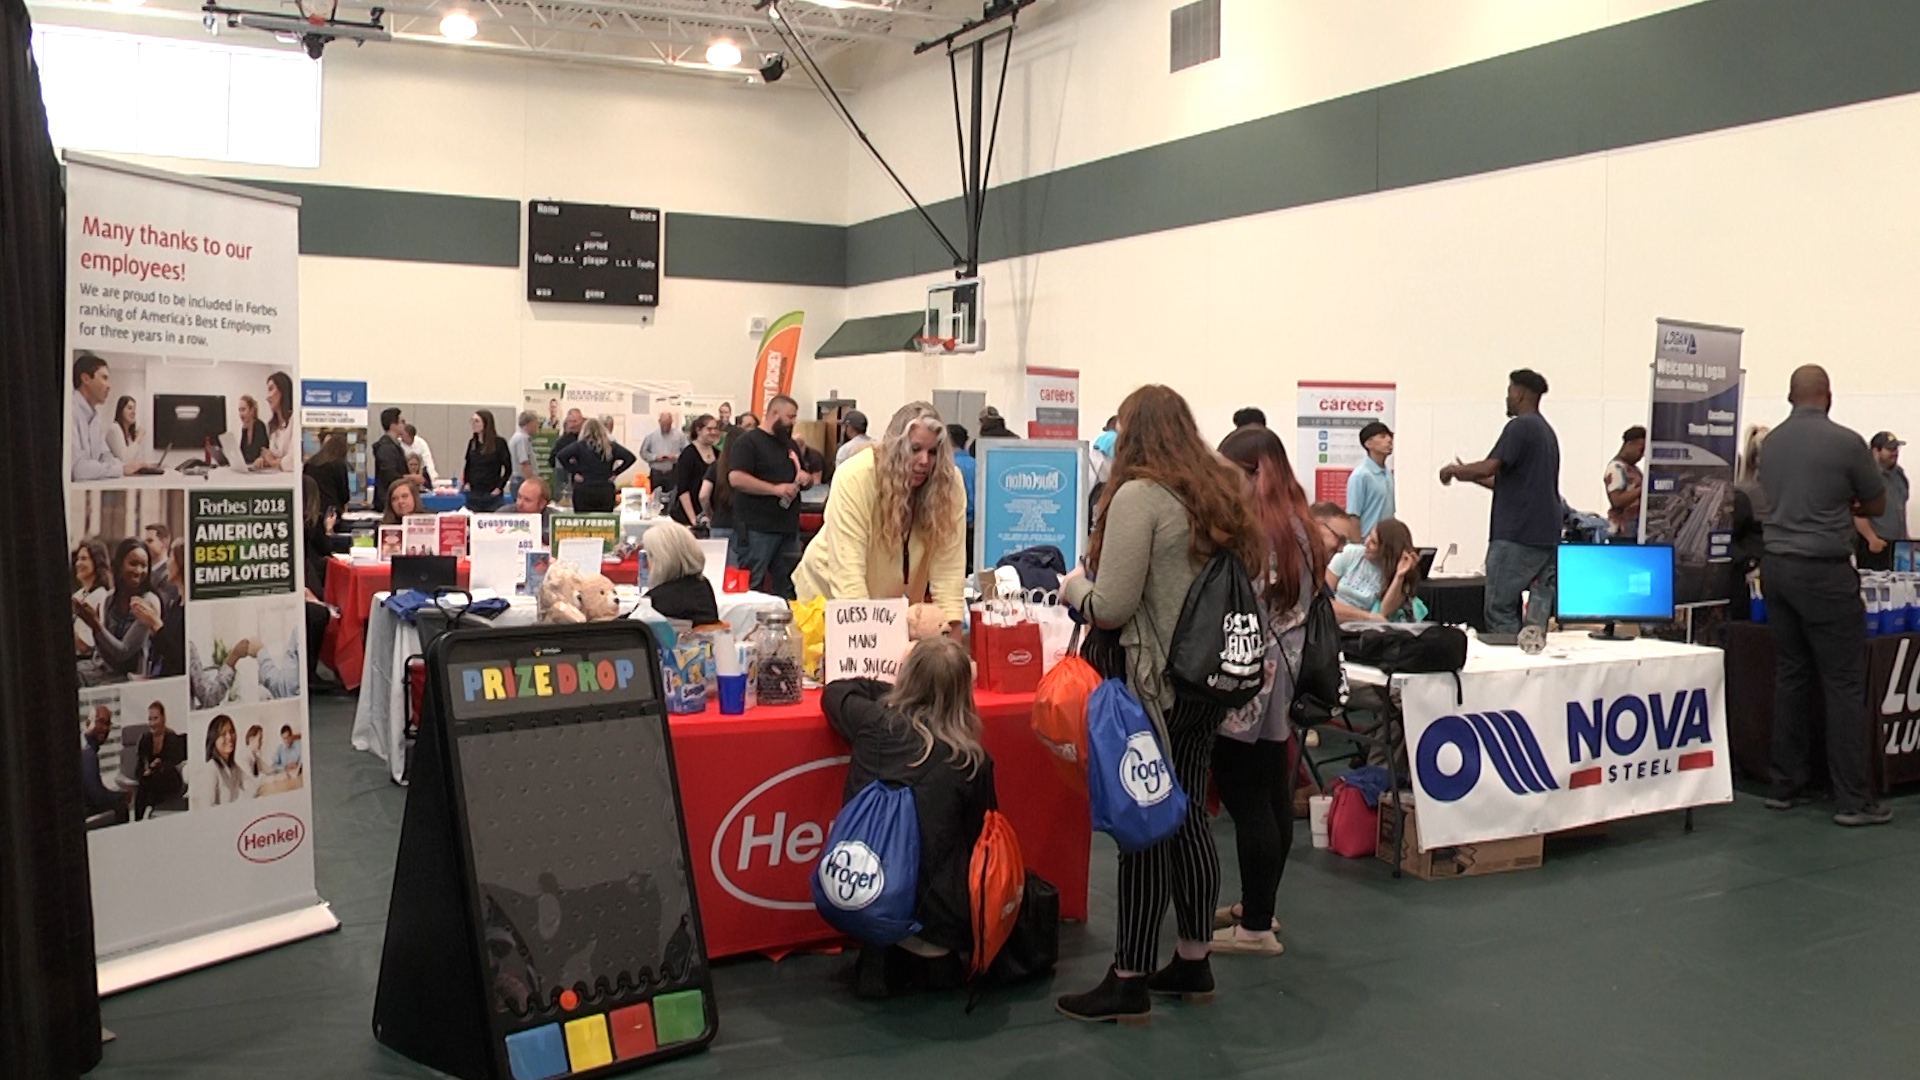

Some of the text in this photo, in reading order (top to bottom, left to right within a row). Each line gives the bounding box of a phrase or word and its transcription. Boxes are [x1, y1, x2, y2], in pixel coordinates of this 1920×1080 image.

[82, 216, 253, 260] Many thanks to our
[81, 252, 186, 281] employees!
[79, 282, 278, 317] We are proud to be included in Forbes
[79, 304, 272, 336] ranking of America's Best Employers
[79, 322, 208, 346] for three years in a row.
[1040, 388, 1075, 403] careers
[1319, 398, 1385, 412] careers
[199, 498, 286, 516] Forbes 2018
[195, 521, 288, 542] AMERICA'S
[195, 543, 289, 563] BEST LARGE
[195, 562, 290, 585] EMPLOYERS
[837, 606, 897, 625] GUESS HOW
[848, 632, 877, 649] MANY
[839, 657, 857, 674] WIN
[462, 659, 635, 702] PRIZE DROP
[1566, 688, 1713, 764] NOVA
[1608, 759, 1672, 783] STEEL
[244, 825, 298, 851] Henkel
